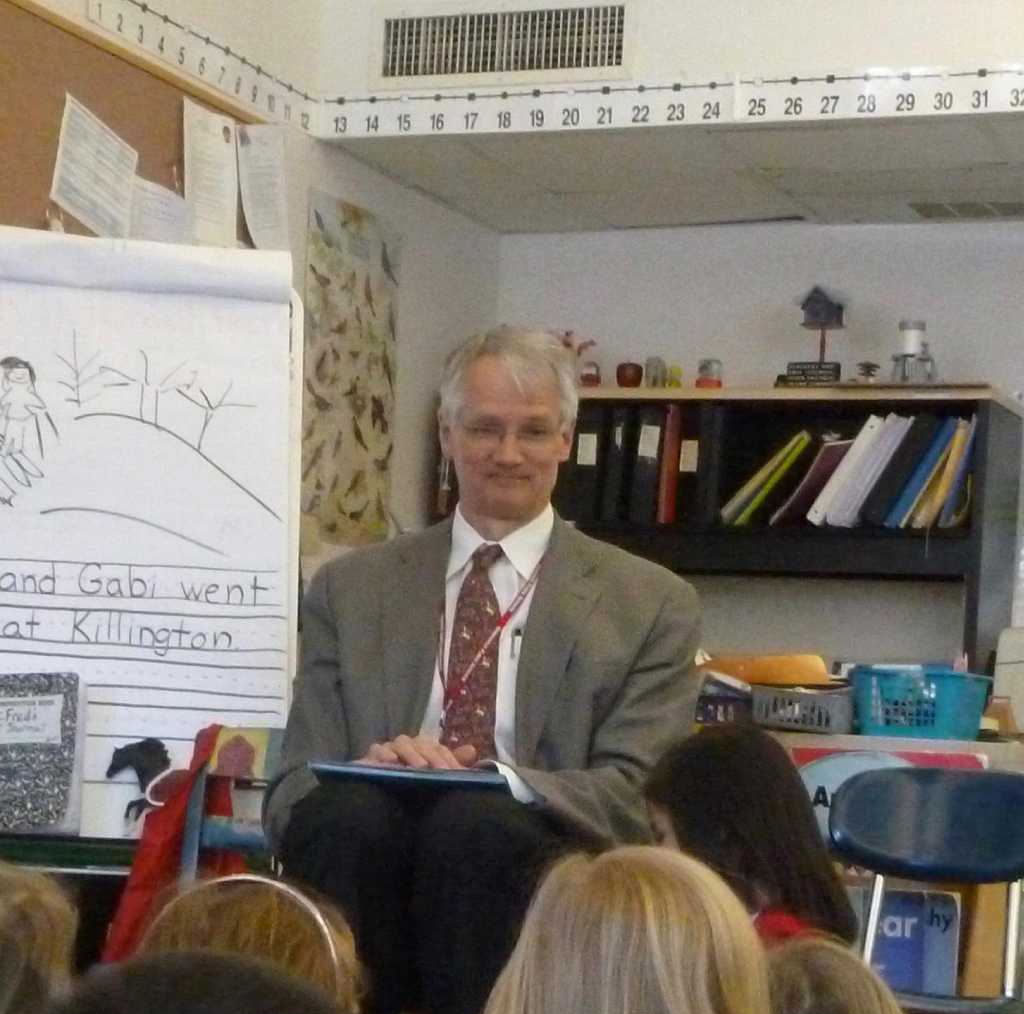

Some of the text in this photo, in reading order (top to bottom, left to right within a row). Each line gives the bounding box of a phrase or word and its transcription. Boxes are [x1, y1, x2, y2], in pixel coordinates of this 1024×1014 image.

[96, 3, 103, 21] 1
[116, 13, 123, 33] 2
[137, 25, 144, 45] 3
[157, 36, 165, 54] 4
[177, 47, 185, 65] 5
[198, 57, 206, 76] 6
[219, 66, 226, 85] 7
[251, 85, 258, 104] 9
[300, 112, 310, 130] 12
[333, 116, 347, 134] 13
[365, 115, 379, 133] 14
[396, 114, 411, 131] 15
[430, 113, 444, 130] 16
[463, 112, 478, 129] 17
[497, 111, 511, 128] 18
[529, 109, 545, 127] 19
[561, 107, 580, 127] 20
[596, 106, 613, 125] 21
[631, 105, 650, 123] 22
[666, 103, 685, 121] 23
[702, 101, 720, 119] 24
[747, 98, 766, 116] 25
[784, 96, 802, 115] 26
[820, 95, 840, 114] 27
[856, 94, 876, 113] 28
[895, 93, 915, 112] 29
[933, 91, 953, 110] 30
[971, 89, 989, 109] 31
[77, 562, 157, 600] Gabi
[179, 574, 270, 608] went
[1, 608, 41, 638] at
